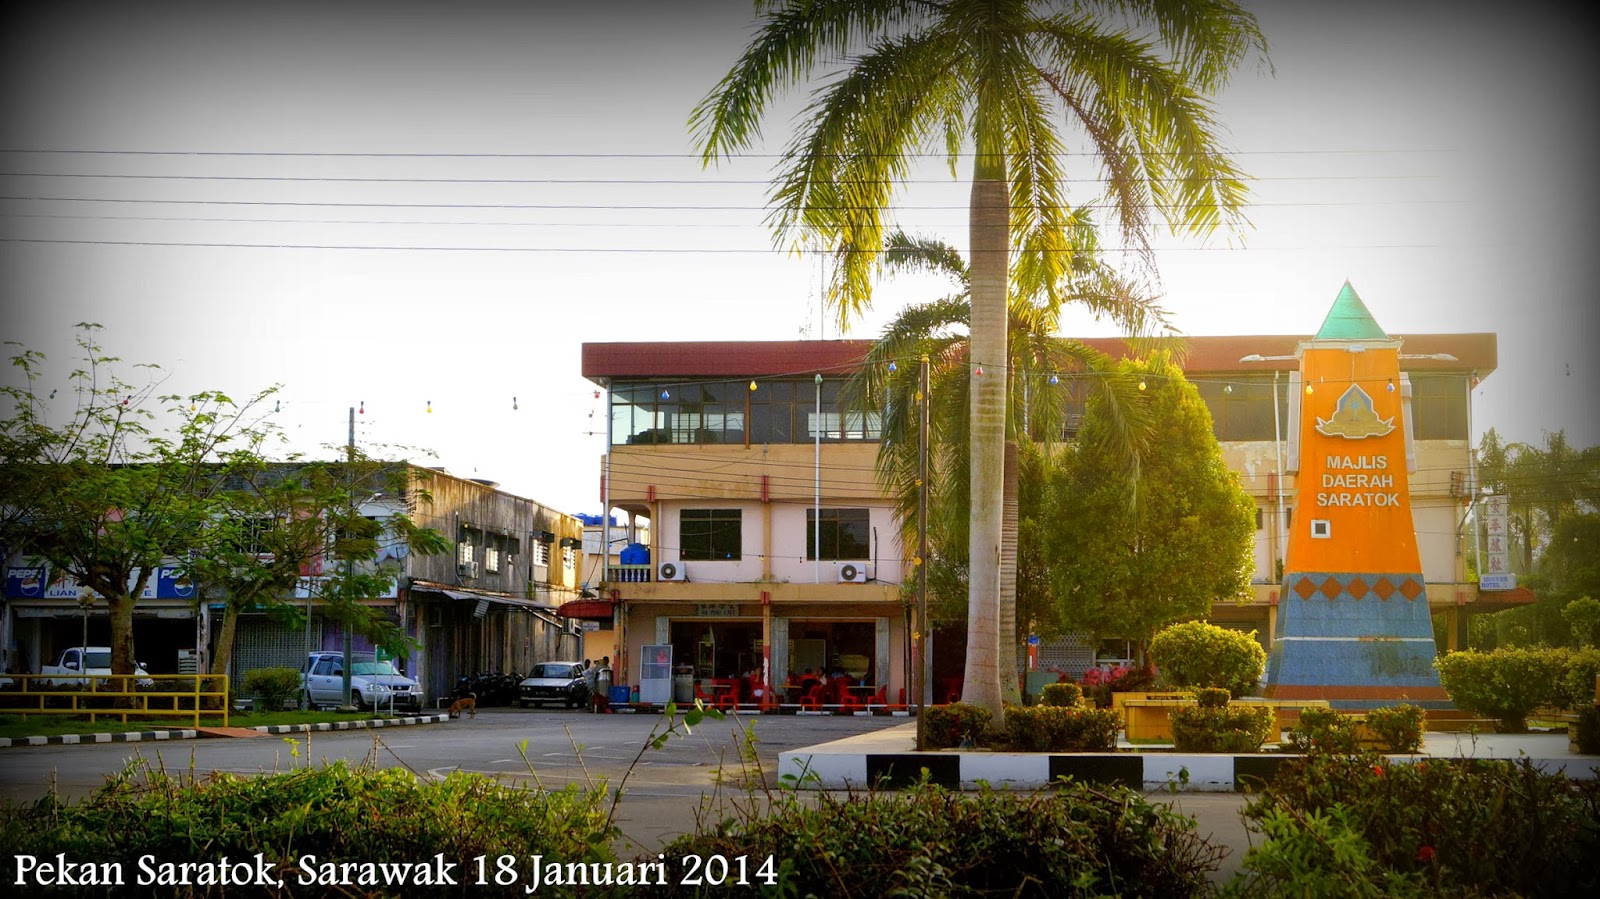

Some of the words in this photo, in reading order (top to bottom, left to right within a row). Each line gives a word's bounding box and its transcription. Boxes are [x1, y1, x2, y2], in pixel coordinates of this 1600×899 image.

[1326, 455, 1388, 469] MAJLIS
[1322, 474, 1393, 488] DAERAH
[1316, 492, 1400, 507] SARATOK
